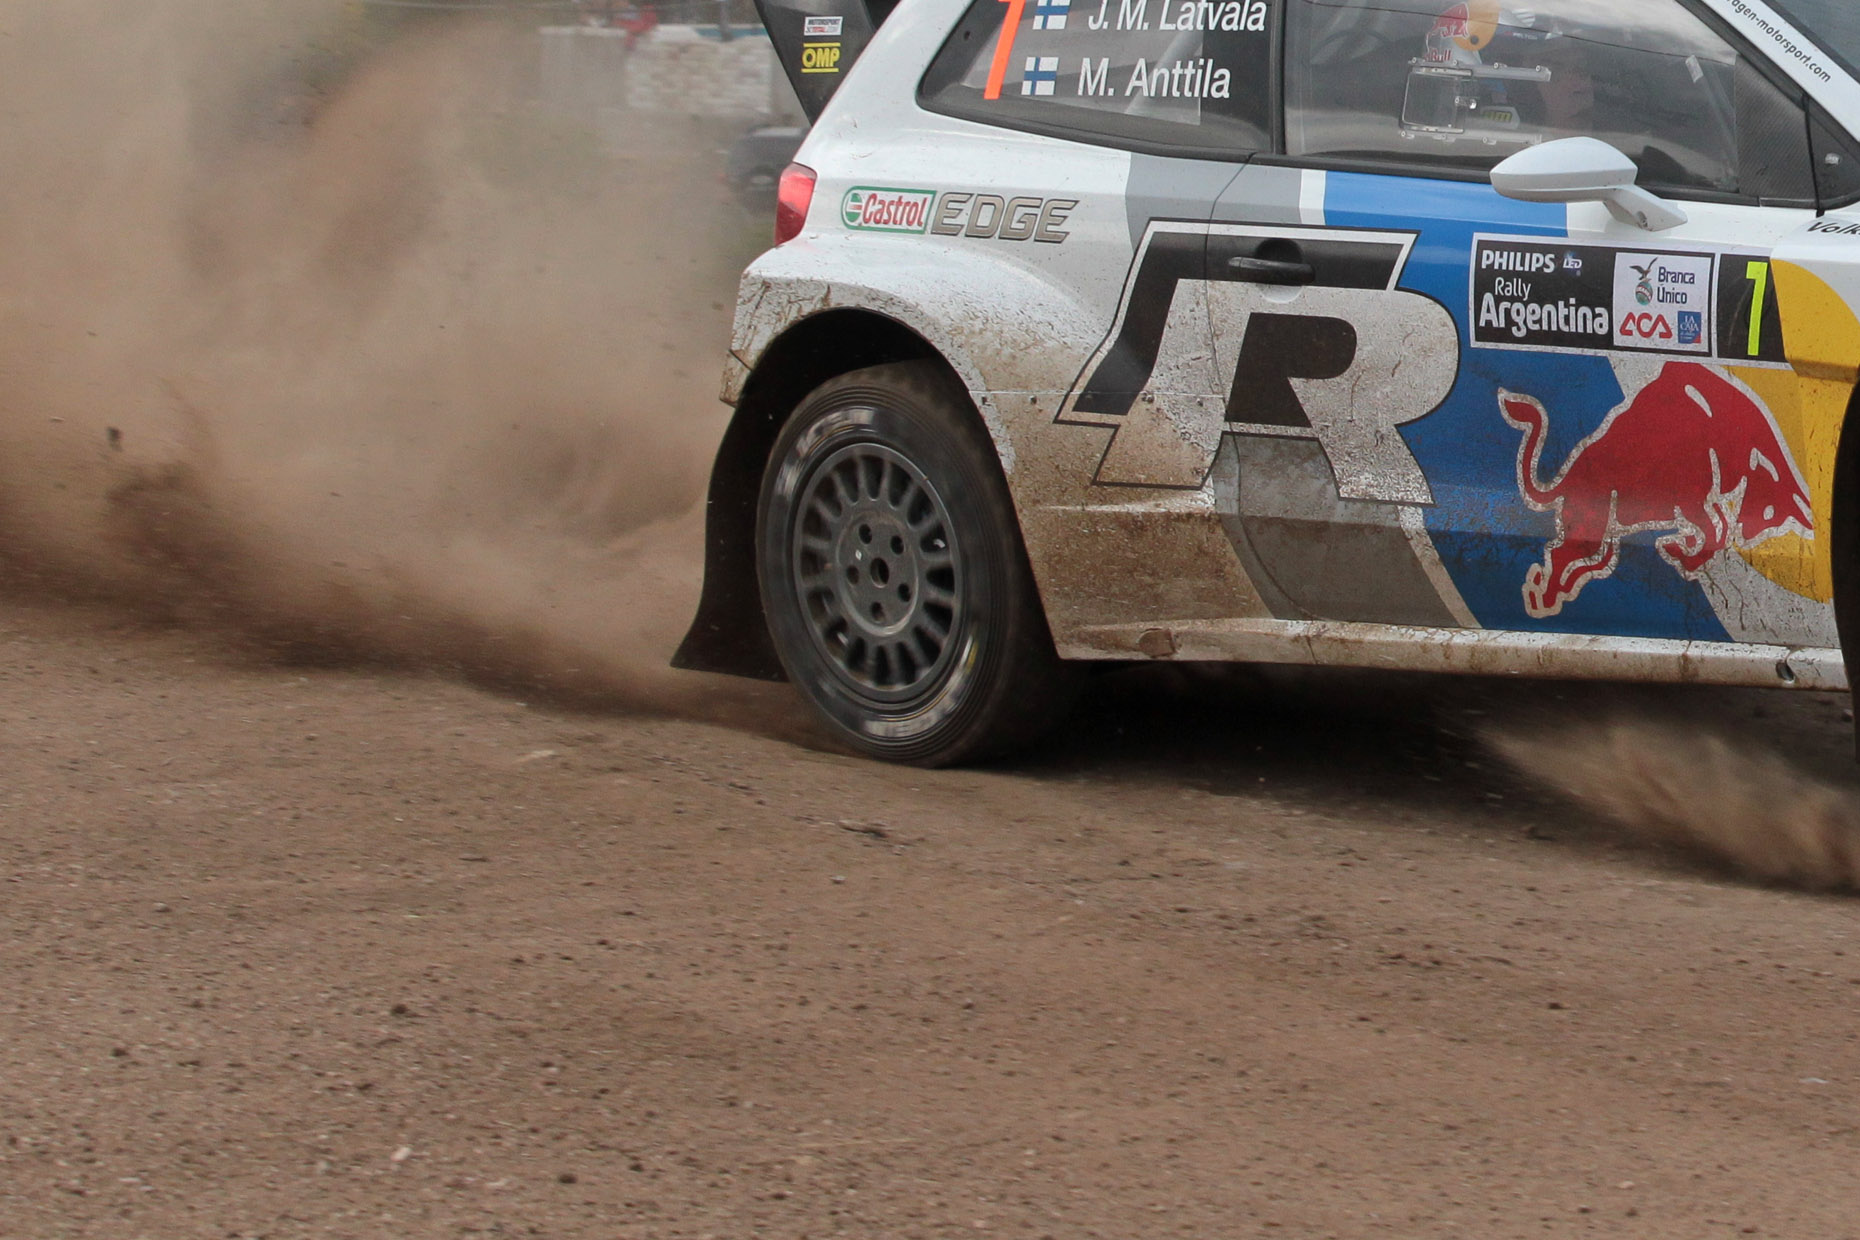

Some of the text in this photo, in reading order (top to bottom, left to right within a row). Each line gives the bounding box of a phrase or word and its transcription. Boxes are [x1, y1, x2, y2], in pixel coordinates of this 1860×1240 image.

[802, 47, 840, 68] OMP
[1077, 57, 1231, 99] M. Anttila
[862, 191, 1080, 244] Castrol EDGE
[1481, 249, 1555, 273] PHILIPS
[1658, 266, 1695, 284] Branca
[1494, 276, 1531, 301] Rally
[1657, 283, 1688, 305] Único
[1479, 292, 1609, 337] Argentina
[1746, 261, 1769, 356] 1
